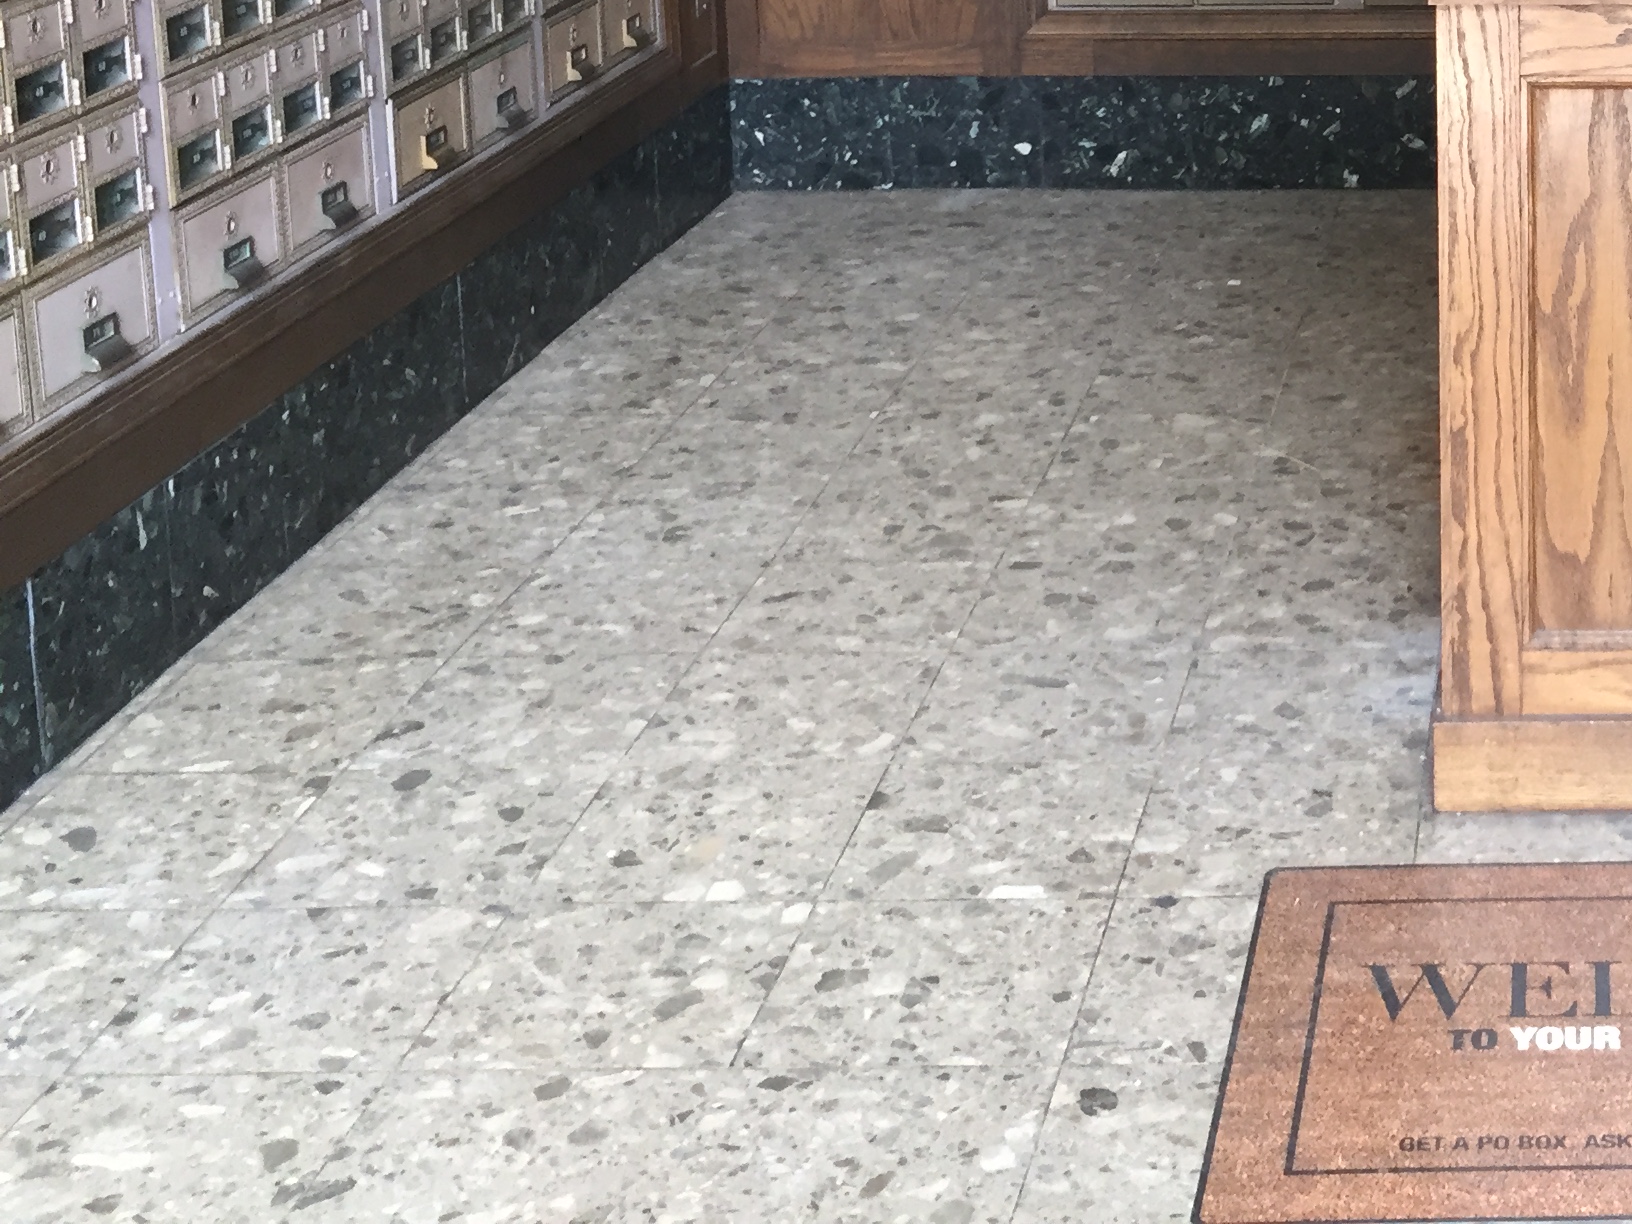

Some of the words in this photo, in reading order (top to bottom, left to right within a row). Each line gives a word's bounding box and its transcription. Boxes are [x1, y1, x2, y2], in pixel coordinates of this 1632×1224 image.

[1448, 1027, 1498, 1051] TO
[1509, 1024, 1621, 1051] YOUR
[1399, 1135, 1443, 1153] GET
[1450, 1135, 1470, 1151] A
[1476, 1134, 1510, 1150] PO
[1584, 1133, 1632, 1149] ASK
